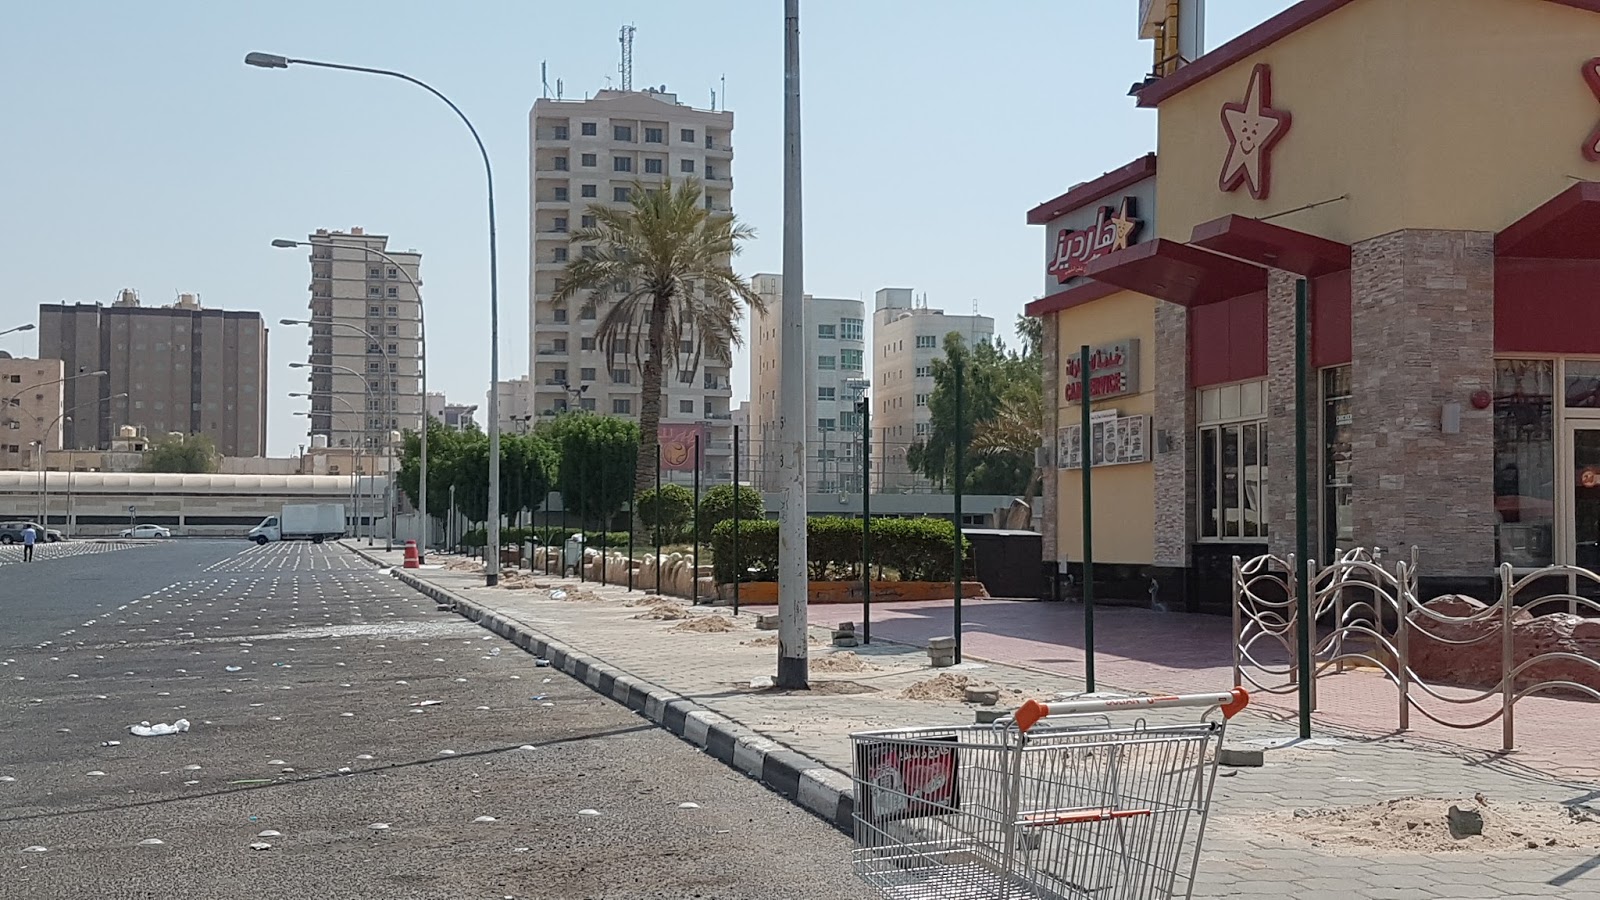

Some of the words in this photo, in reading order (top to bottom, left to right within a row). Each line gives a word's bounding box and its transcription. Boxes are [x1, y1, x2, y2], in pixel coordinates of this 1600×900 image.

[1050, 212, 1117, 271] هارديز
[1066, 354, 1096, 379] الارات
[1096, 346, 1122, 369] خدمة
[1089, 372, 1121, 396] ERVICE
